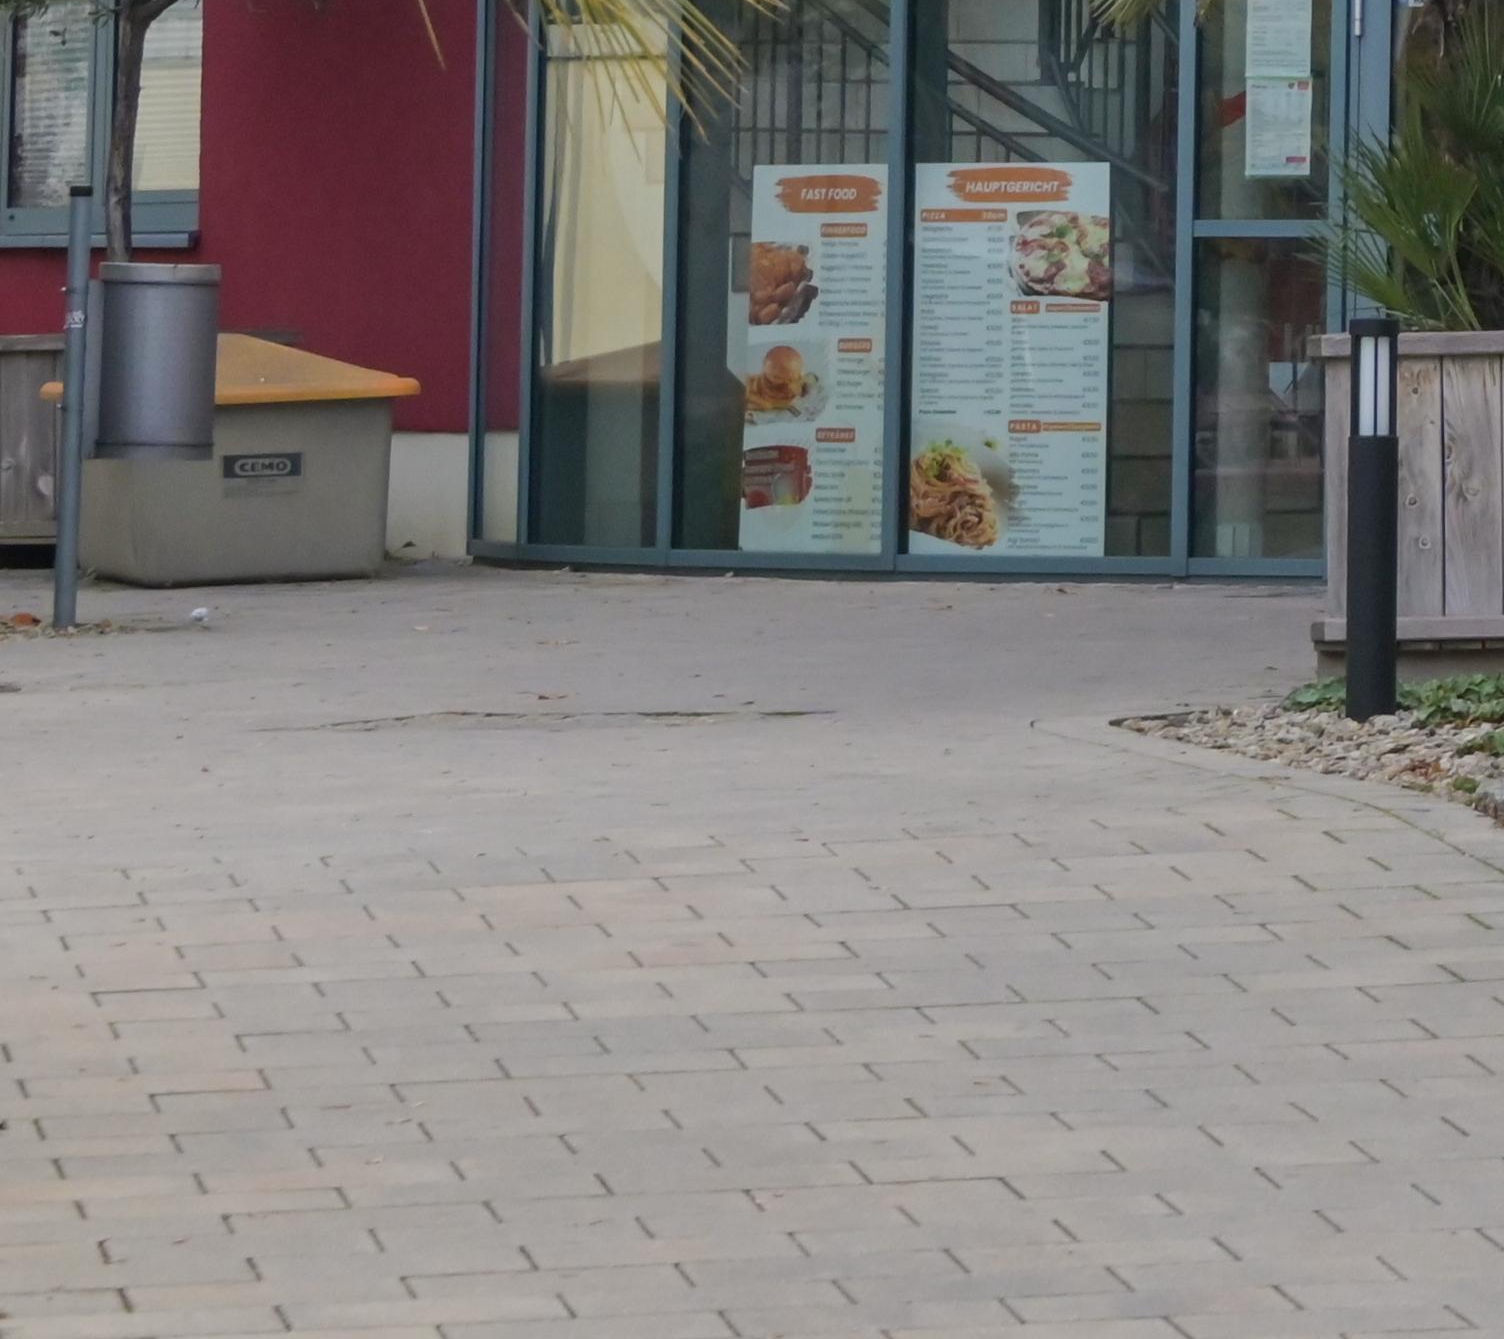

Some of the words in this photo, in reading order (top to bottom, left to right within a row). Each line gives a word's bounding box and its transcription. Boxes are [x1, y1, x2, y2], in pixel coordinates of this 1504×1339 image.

[800, 187, 826, 201] FAST
[827, 187, 857, 201] FOOD
[965, 180, 1060, 194] HAUPTGERICHT
[238, 460, 288, 473] CEMO
